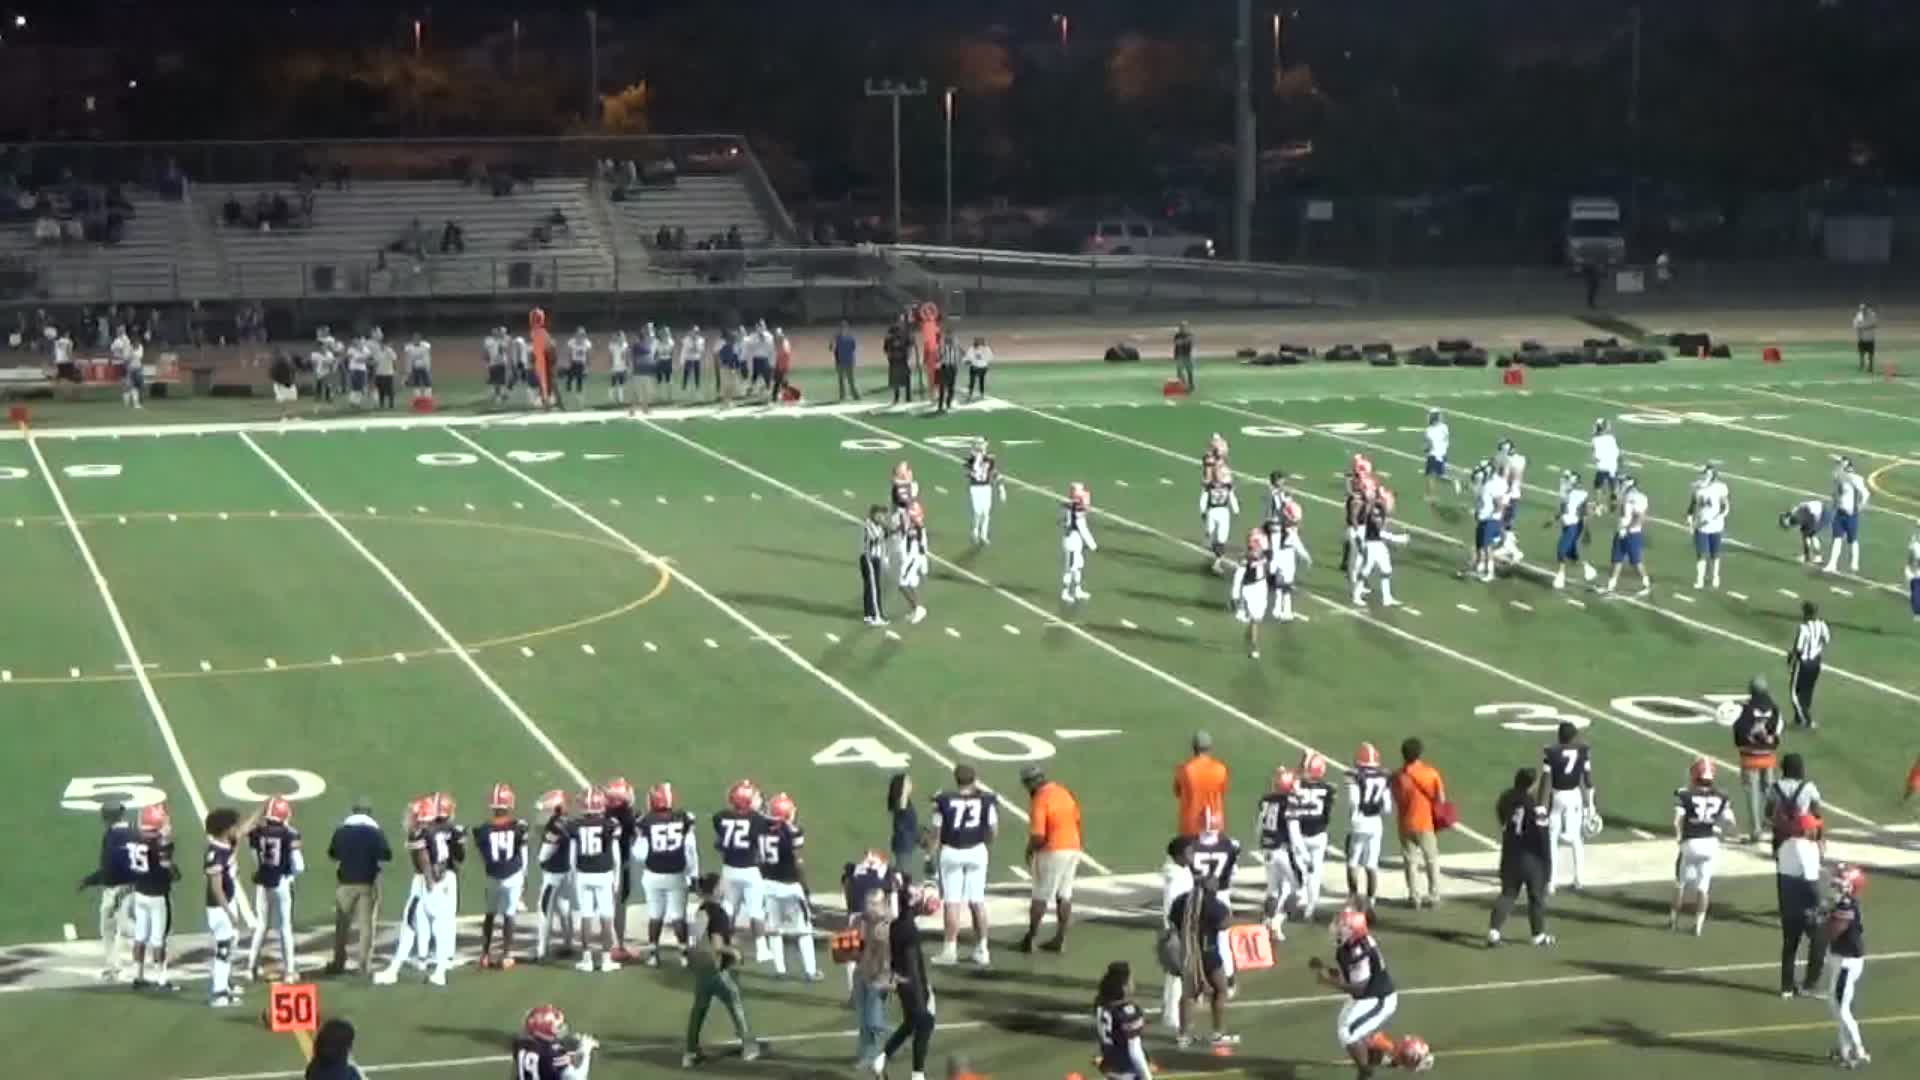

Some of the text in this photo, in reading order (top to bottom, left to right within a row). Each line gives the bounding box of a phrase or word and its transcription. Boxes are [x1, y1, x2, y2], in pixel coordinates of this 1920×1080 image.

[810, 729, 1057, 769] 40
[1562, 748, 1579, 775] 7
[60, 768, 327, 811] 50
[949, 797, 982, 829] 73
[489, 829, 516, 862] 14
[578, 825, 603, 856] 16
[650, 821, 685, 852] 65
[721, 818, 751, 849] 72
[757, 833, 781, 864] 15
[259, 835, 282, 867] 13
[1193, 850, 1229, 878] 57
[275, 992, 313, 1024] 50
[518, 1047, 542, 1080] 19
